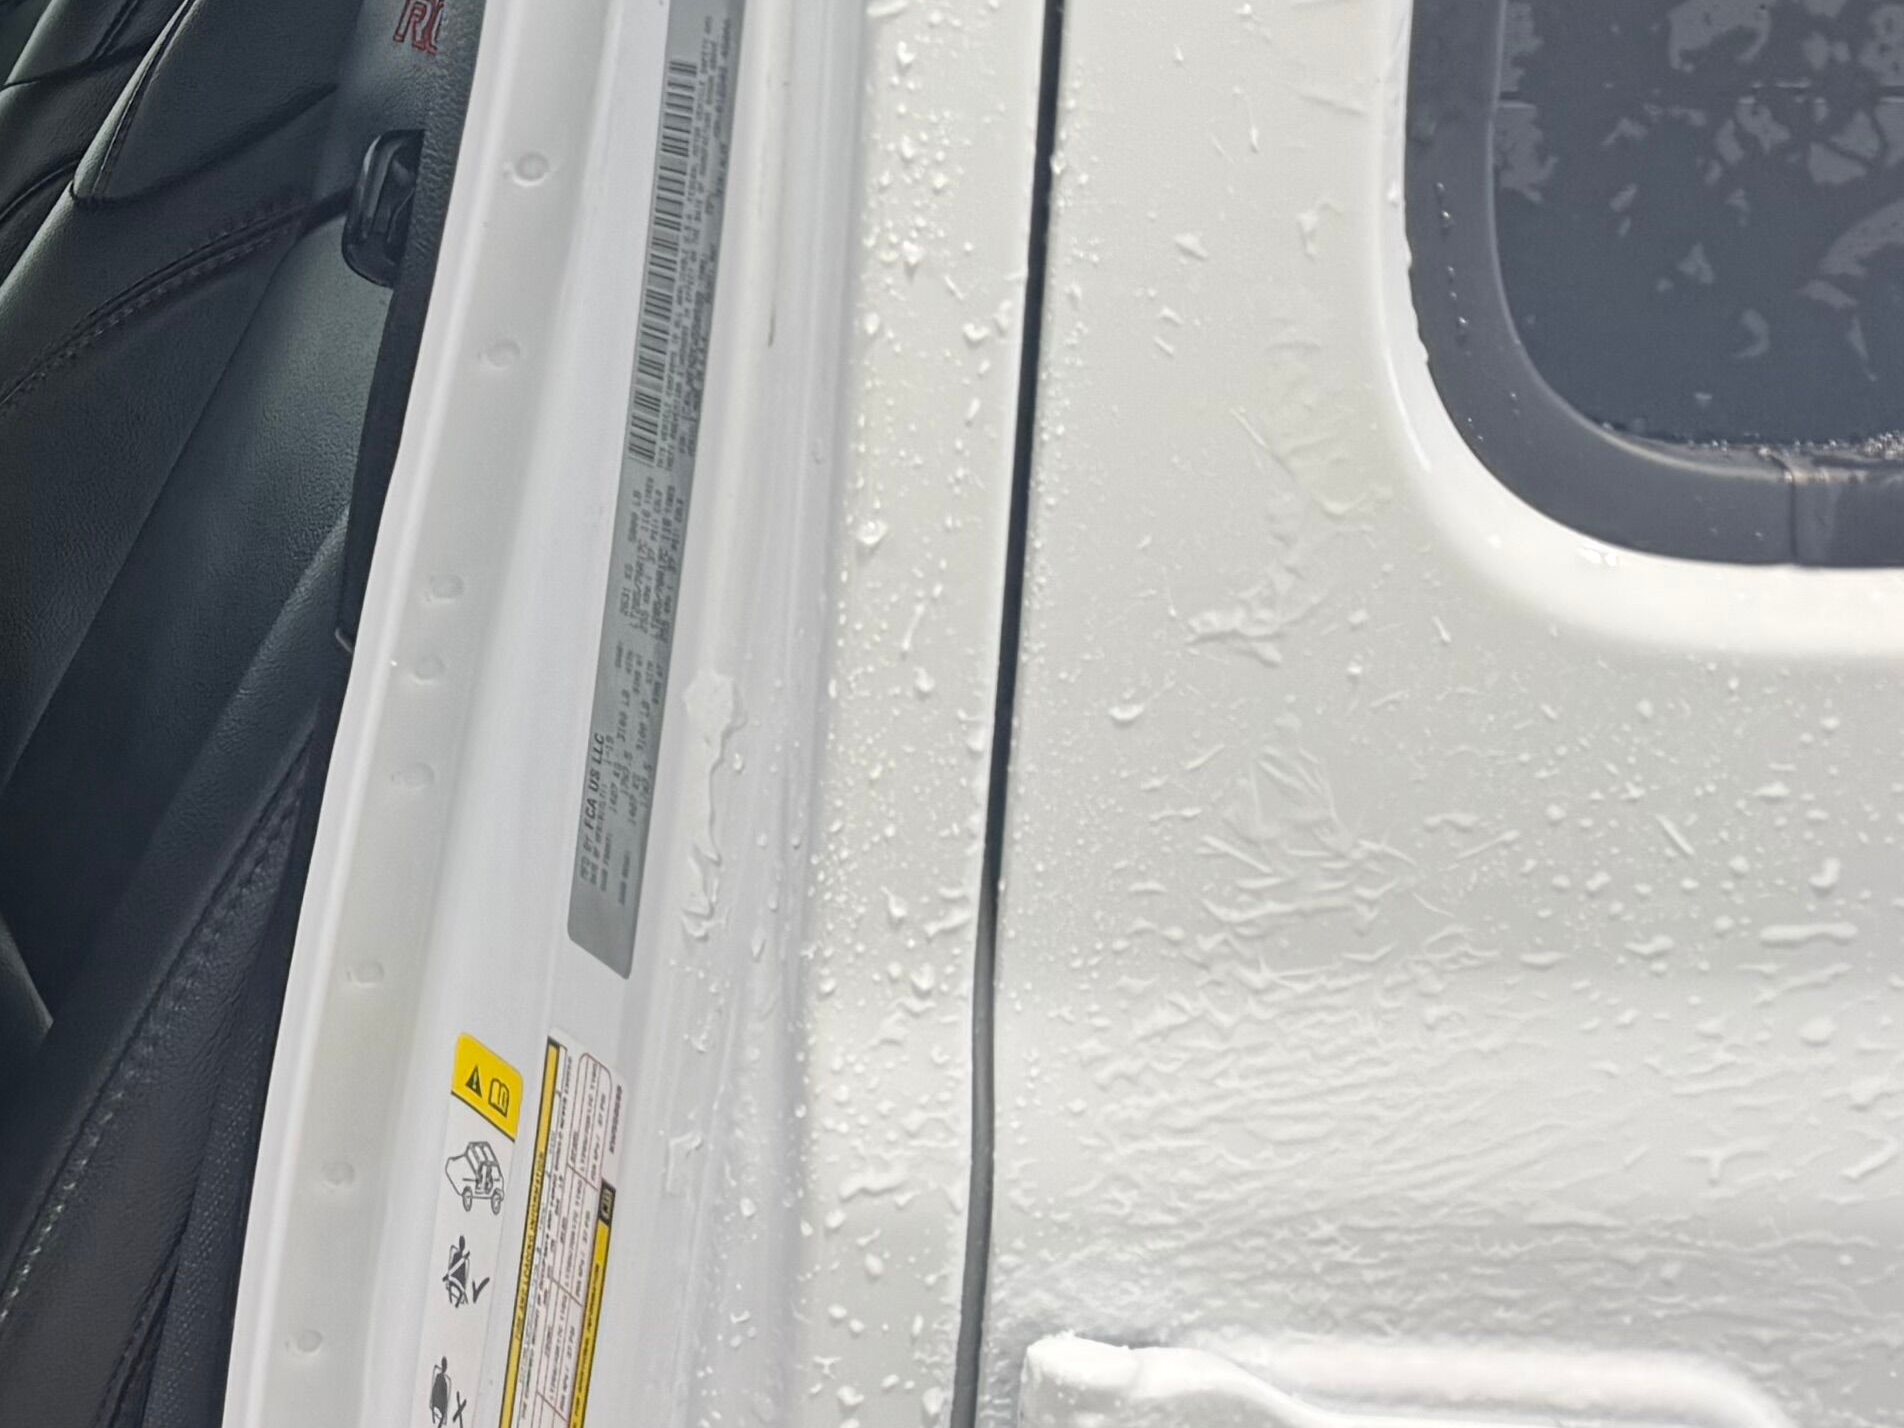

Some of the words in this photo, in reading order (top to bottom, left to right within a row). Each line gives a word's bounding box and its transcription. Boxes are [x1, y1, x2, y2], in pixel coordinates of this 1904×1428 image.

[590, 731, 605, 765] LLC
[587, 767, 601, 793] US
[583, 795, 597, 831] FCA
